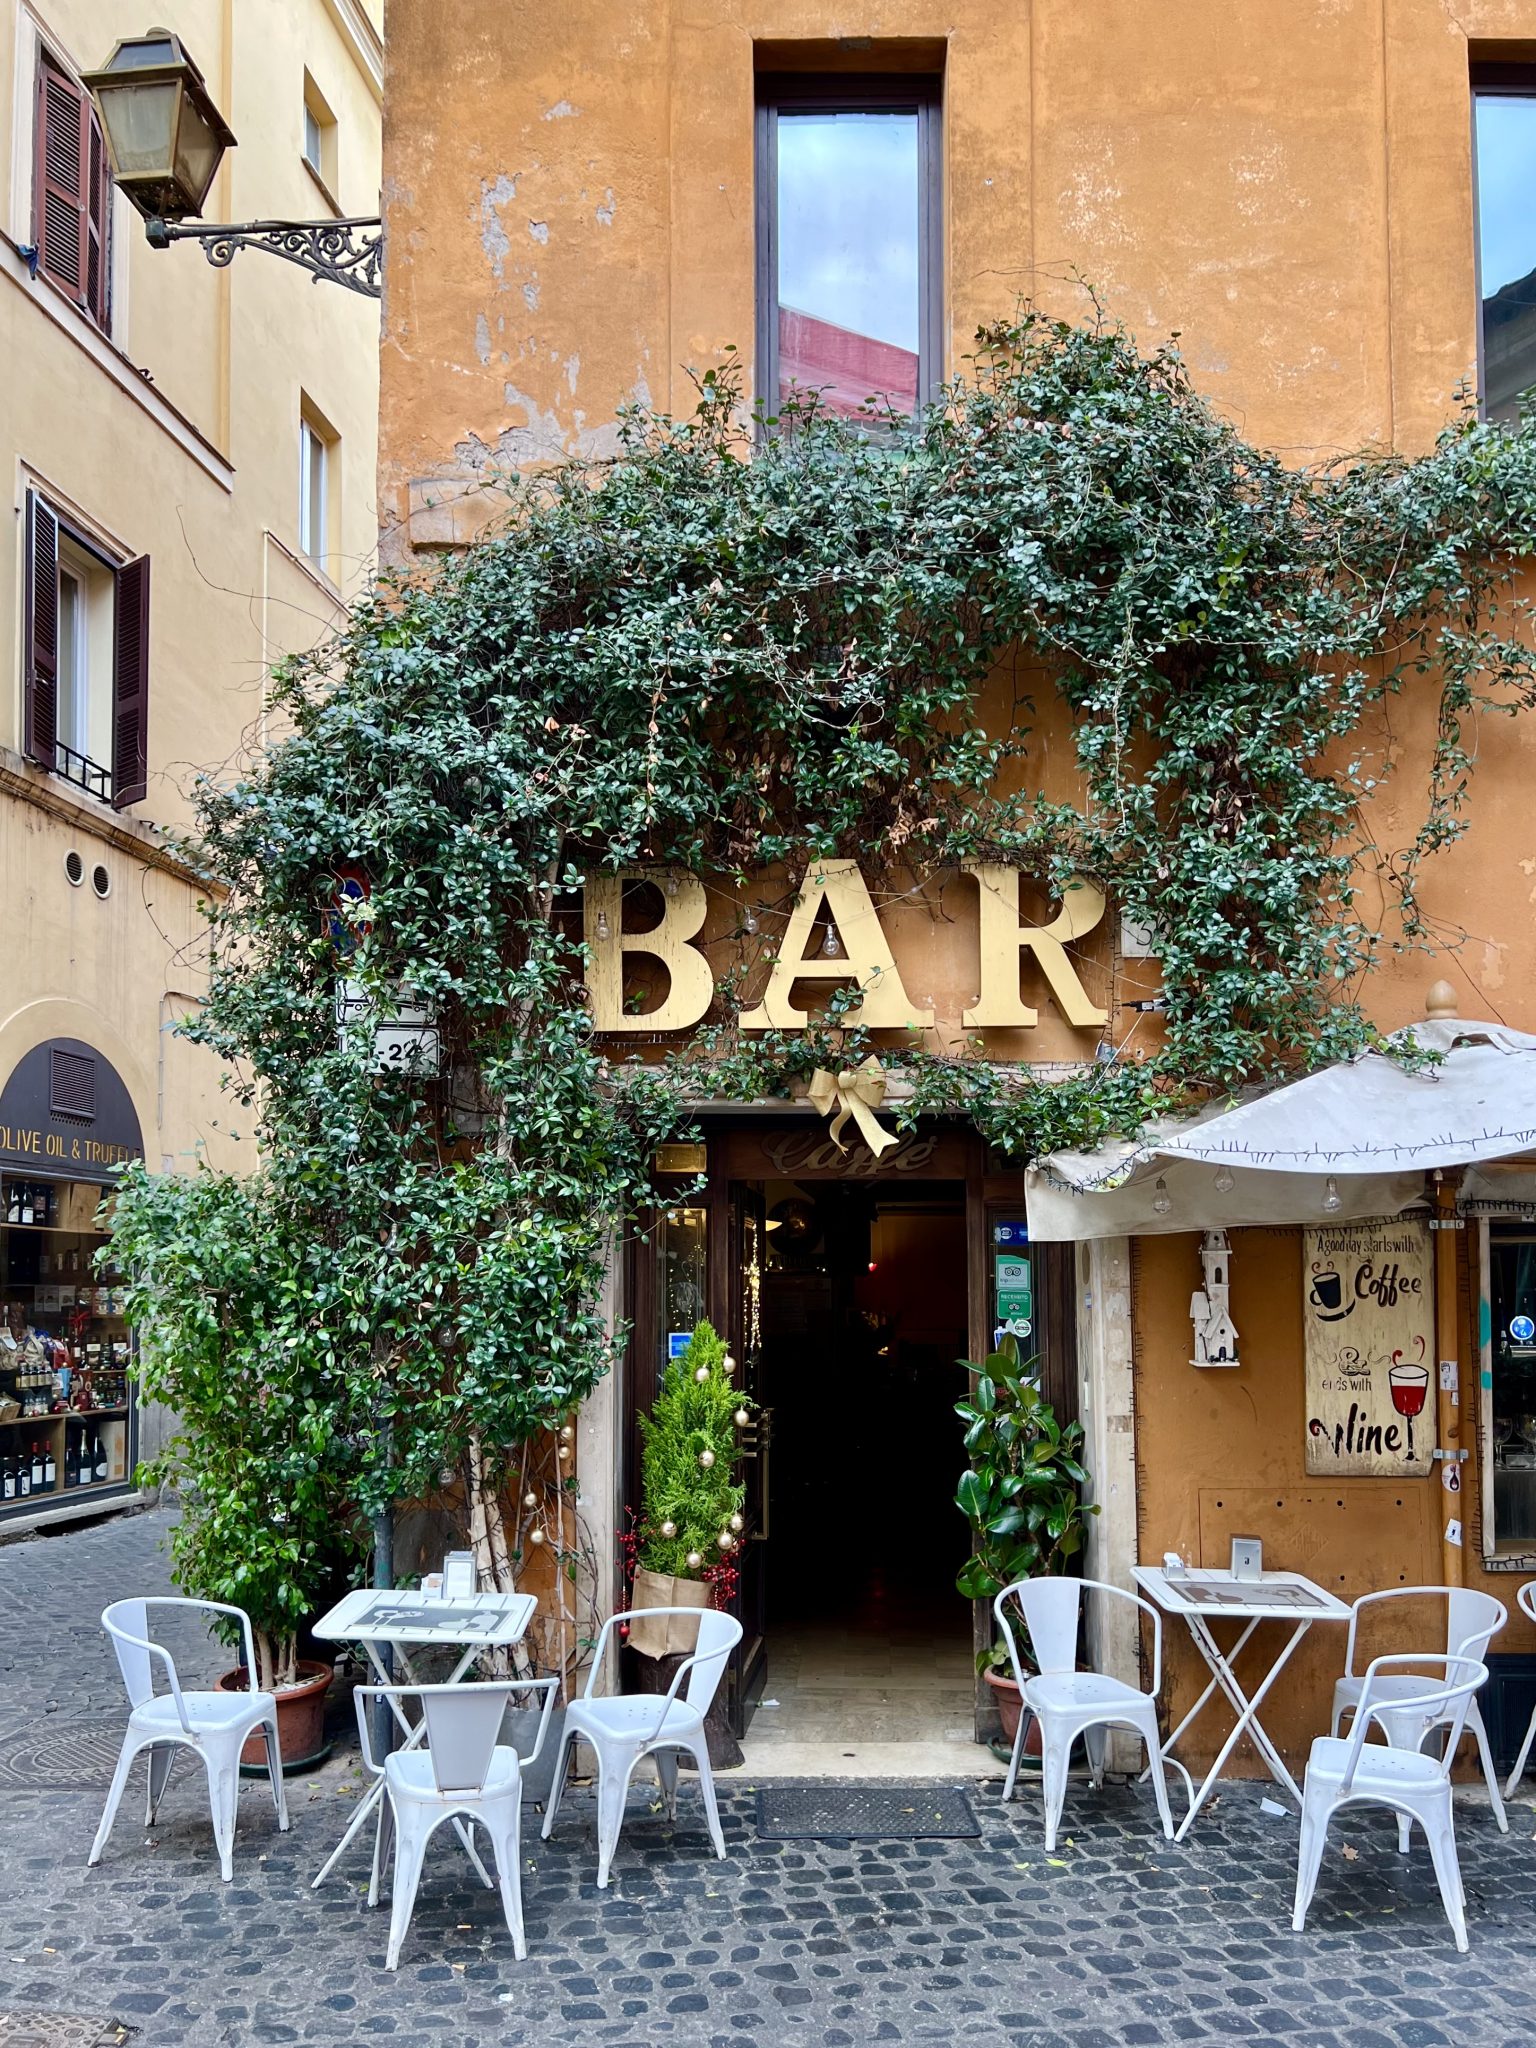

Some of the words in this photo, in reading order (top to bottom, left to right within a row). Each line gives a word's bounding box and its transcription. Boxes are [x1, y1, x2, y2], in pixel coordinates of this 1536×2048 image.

[584, 858, 1109, 1032] BAR
[46, 1134, 68, 1158] OIL
[71, 1138, 81, 1159] &
[1324, 1235, 1345, 1256] good
[1392, 1234, 1414, 1253] with
[1355, 1264, 1422, 1307] Coffee
[1338, 1346, 1371, 1376] &
[1350, 1378, 1372, 1391] with
